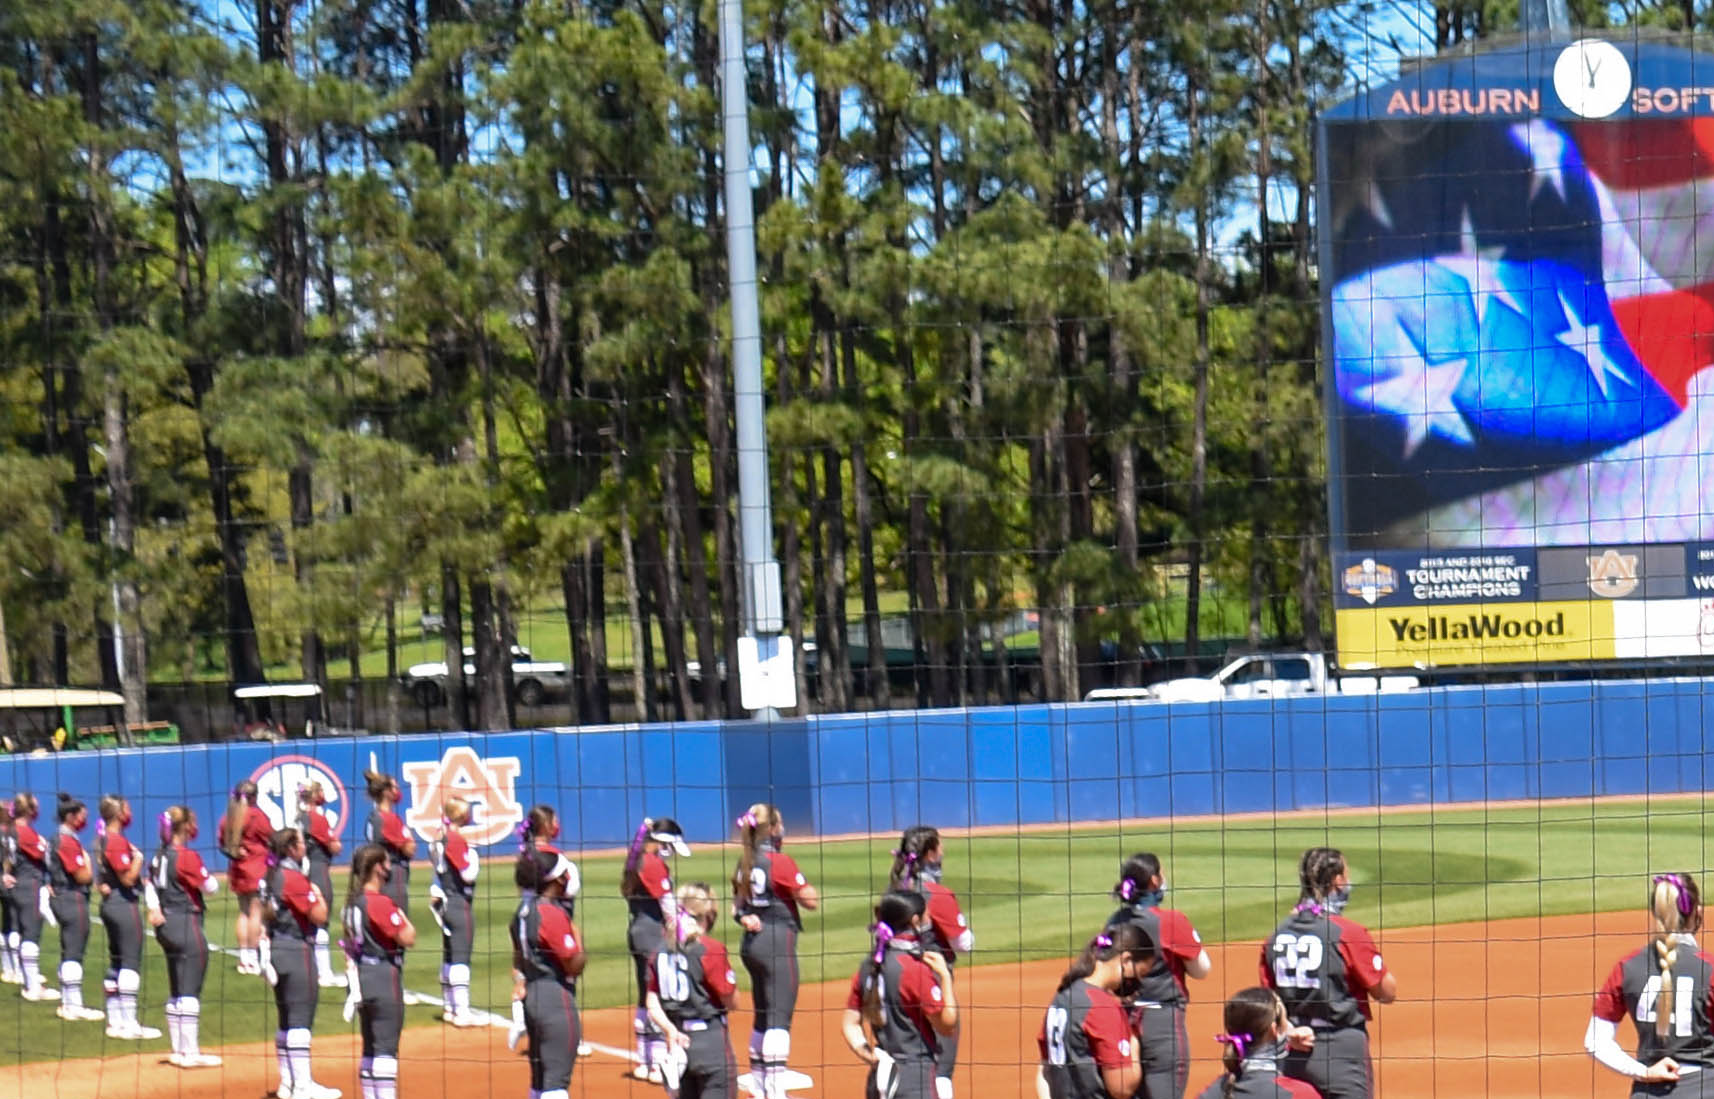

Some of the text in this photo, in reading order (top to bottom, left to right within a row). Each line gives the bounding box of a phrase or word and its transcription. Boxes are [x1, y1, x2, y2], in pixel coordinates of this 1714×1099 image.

[1387, 88, 1540, 115] AUBURN
[1406, 565, 1531, 584] TOURNAMENT
[1413, 581, 1521, 599] CHAMPIONS
[1389, 612, 1565, 641] YellaWood
[1273, 934, 1323, 989] 22
